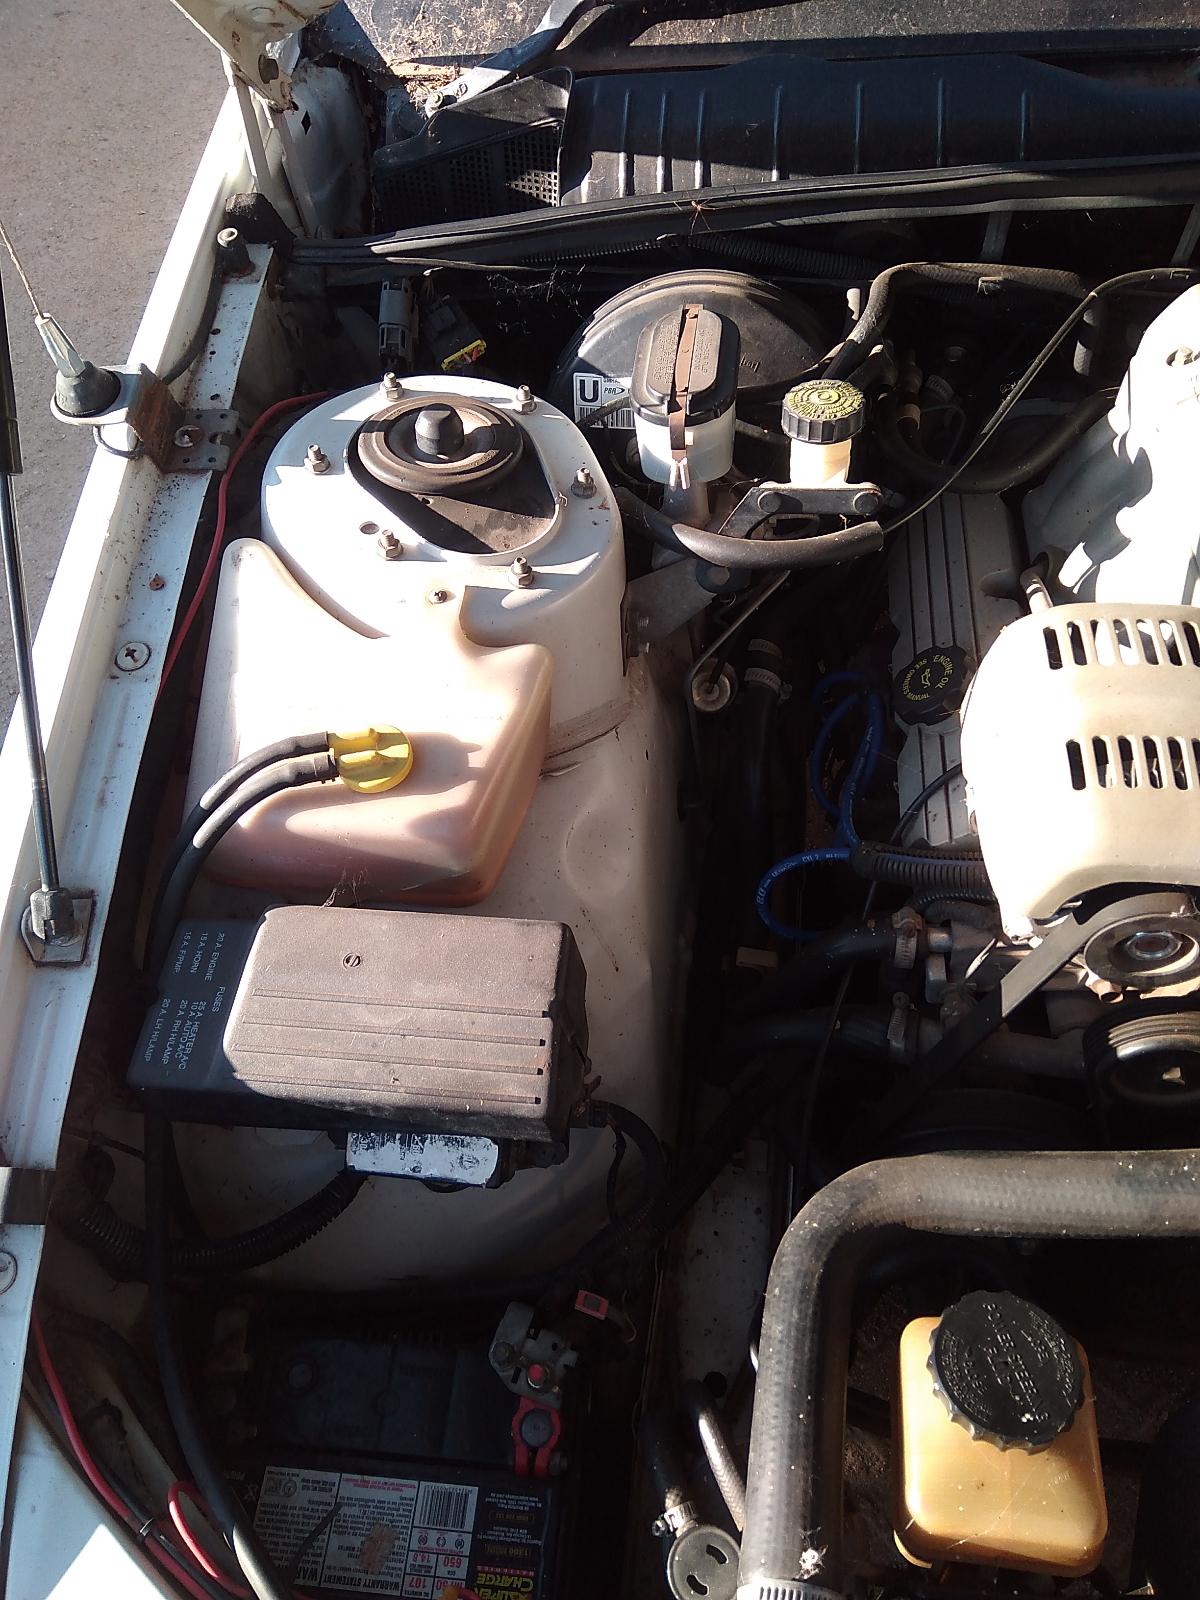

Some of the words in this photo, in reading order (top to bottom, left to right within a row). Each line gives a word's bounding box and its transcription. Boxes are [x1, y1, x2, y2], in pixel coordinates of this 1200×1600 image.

[580, 379, 599, 403] U
[914, 658, 927, 669] SEE
[933, 654, 953, 676] ENGINE
[934, 677, 949, 689] OIL
[906, 692, 930, 701] MANUAL
[183, 931, 191, 939] 15
[201, 932, 208, 940] 15
[217, 932, 224, 941] 20
[190, 950, 202, 973] HORN
[205, 951, 219, 982] ENGINE
[179, 999, 187, 1009] 20
[191, 1001, 198, 1010] 10
[198, 1000, 206, 1011] 25
[212, 986, 226, 1013] FUSES
[154, 1018, 163, 1029] LH
[172, 1019, 181, 1032] RH
[180, 1020, 192, 1043] AUTO
[184, 1021, 200, 1054] HEATER
[982, 1303, 1015, 1352] POWER
[1007, 1354, 1049, 1423] STEERING
[443, 1556, 462, 1569] 650
[362, 1576, 400, 1591] WARRANTY
[409, 1577, 426, 1589] 107
[477, 1573, 534, 1592] CHARGE
